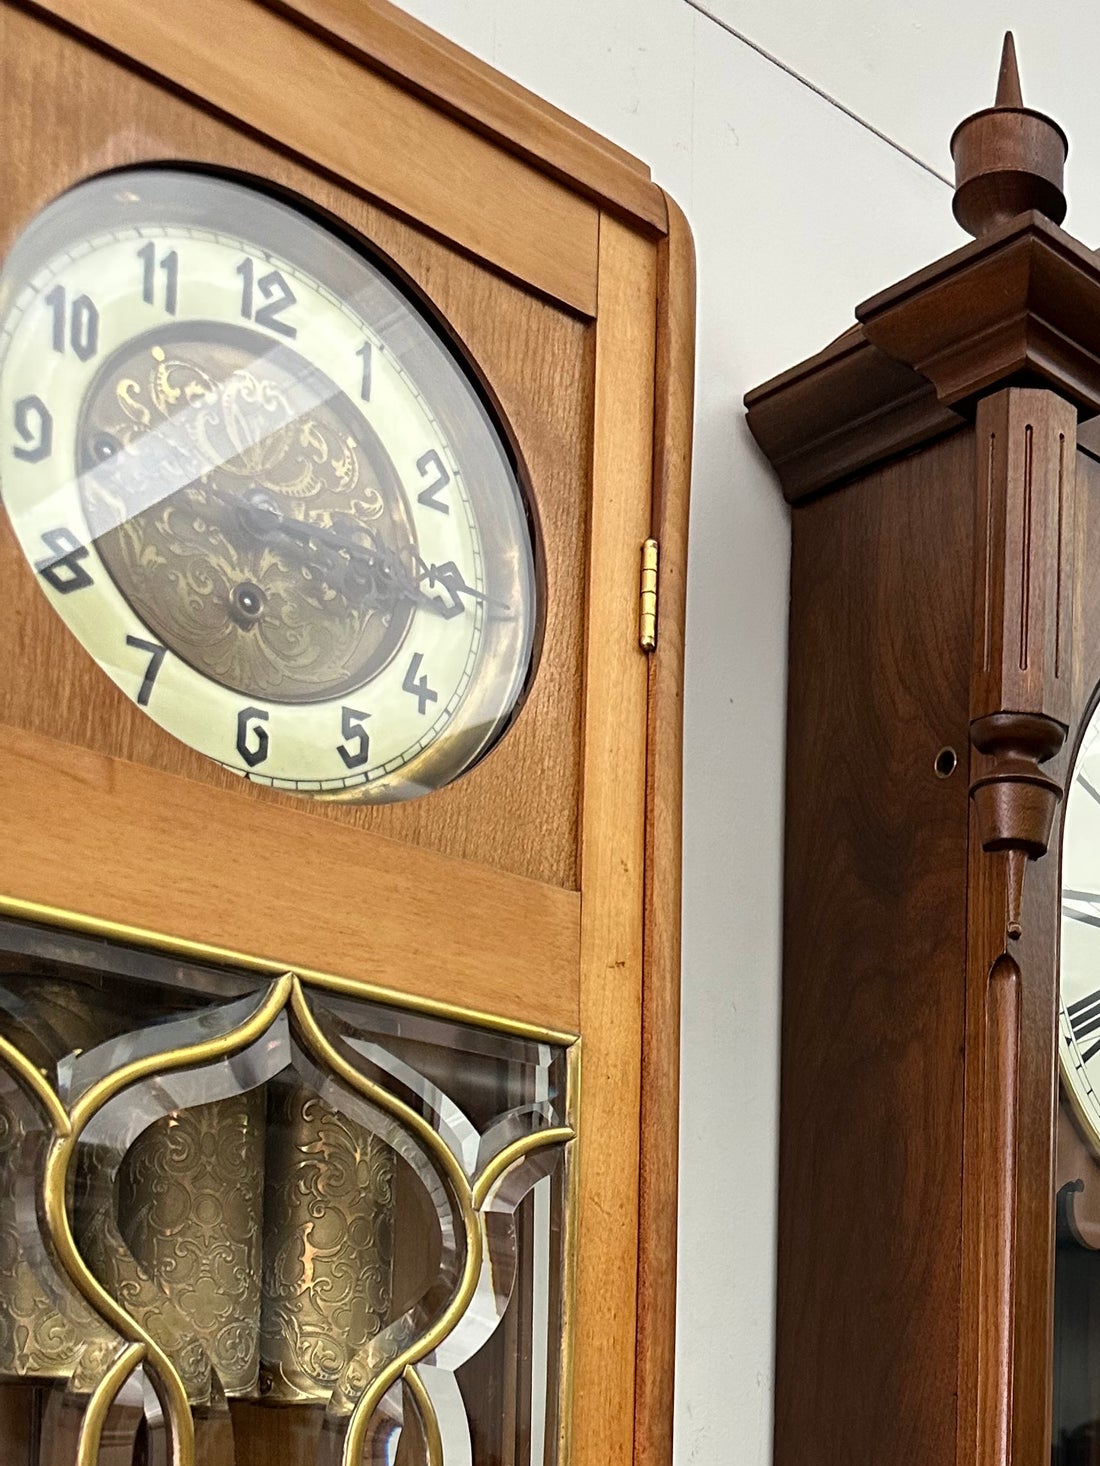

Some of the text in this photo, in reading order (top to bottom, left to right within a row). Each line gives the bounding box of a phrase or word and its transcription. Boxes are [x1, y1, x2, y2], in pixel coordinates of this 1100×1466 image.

[137, 241, 178, 314] 11
[236, 257, 297, 337] 12
[45, 285, 98, 361] 10
[355, 342, 373, 401] 1
[13, 394, 53, 462] 9
[417, 449, 451, 514] 2
[38, 527, 94, 595] 8
[126, 634, 168, 705] 7
[403, 652, 438, 714] 4
[236, 706, 269, 767] 6
[337, 707, 372, 768] 5
